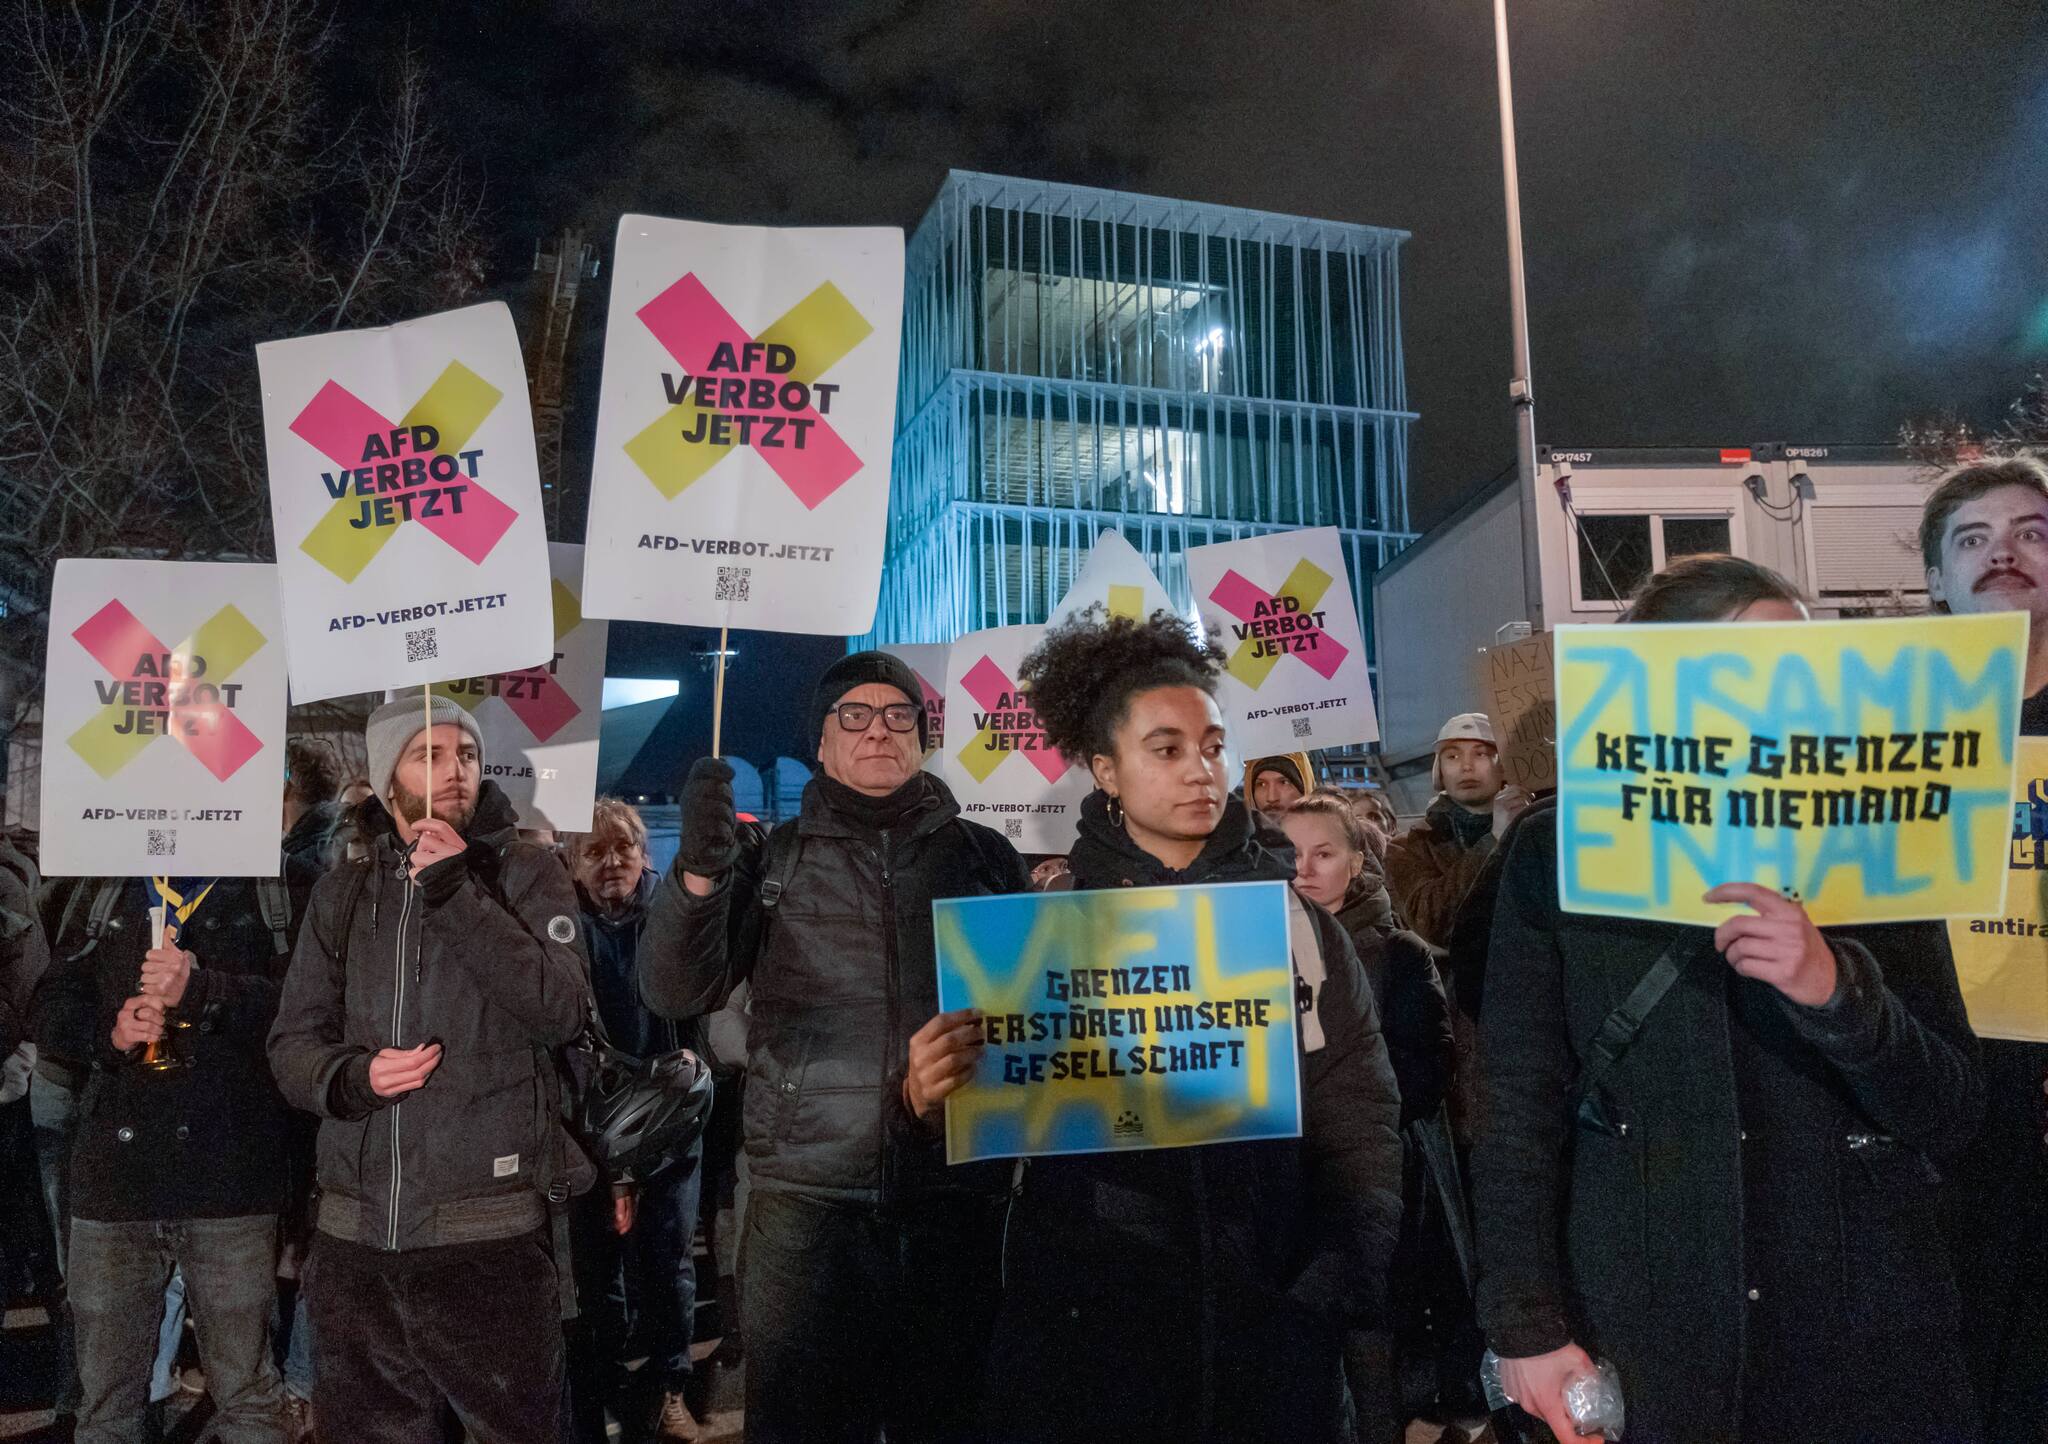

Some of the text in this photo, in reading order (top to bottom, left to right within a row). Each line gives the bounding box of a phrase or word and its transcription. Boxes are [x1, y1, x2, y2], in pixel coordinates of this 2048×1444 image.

[707, 342, 796, 374] AFD
[661, 373, 840, 414] VERBOT
[361, 425, 440, 462] AFD
[681, 414, 815, 449] JETZT
[321, 450, 483, 498] VERBOT
[1551, 453, 1591, 463] OP17457
[349, 485, 468, 529] JETZT
[638, 534, 834, 562] AFD-VERBOT.JETZT
[328, 593, 507, 631] AFD-VERBOT.JETZT
[1253, 596, 1300, 618] AFD
[1231, 612, 1326, 640] VERBOT
[1251, 633, 1320, 658] JETZT
[448, 674, 546, 700] JETZT
[1247, 697, 1348, 720] AFD-VERBOT.JETZT
[1596, 730, 1981, 779] KEINE GRENZEN
[966, 804, 1066, 814] AFD-VERBOT.JETZT
[1621, 778, 1952, 829] FÜR NIEMAND
[1046, 964, 1191, 1001] GRENZEN
[972, 998, 1270, 1046] ERSTÖREN UNSERE
[1004, 1041, 1244, 1085] GESELLSCHAFT
